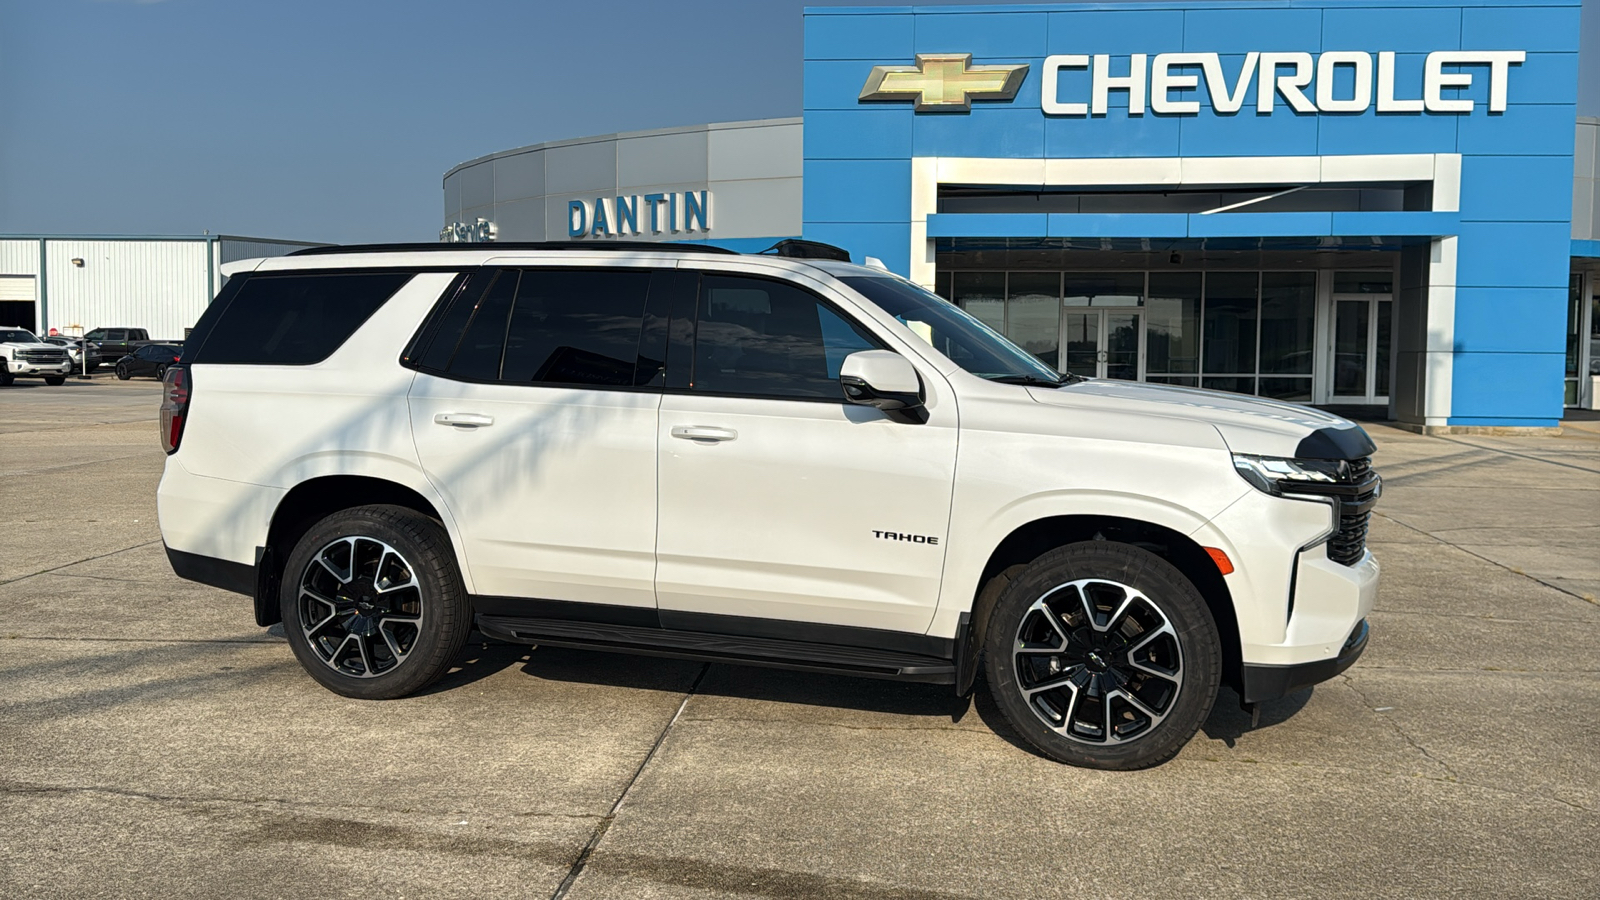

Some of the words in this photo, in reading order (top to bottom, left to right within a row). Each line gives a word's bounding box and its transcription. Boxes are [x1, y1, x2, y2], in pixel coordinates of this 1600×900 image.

[1041, 51, 1526, 115] CHEVROLET
[568, 190, 710, 238] DANTIN
[872, 529, 939, 546] TAHOE
